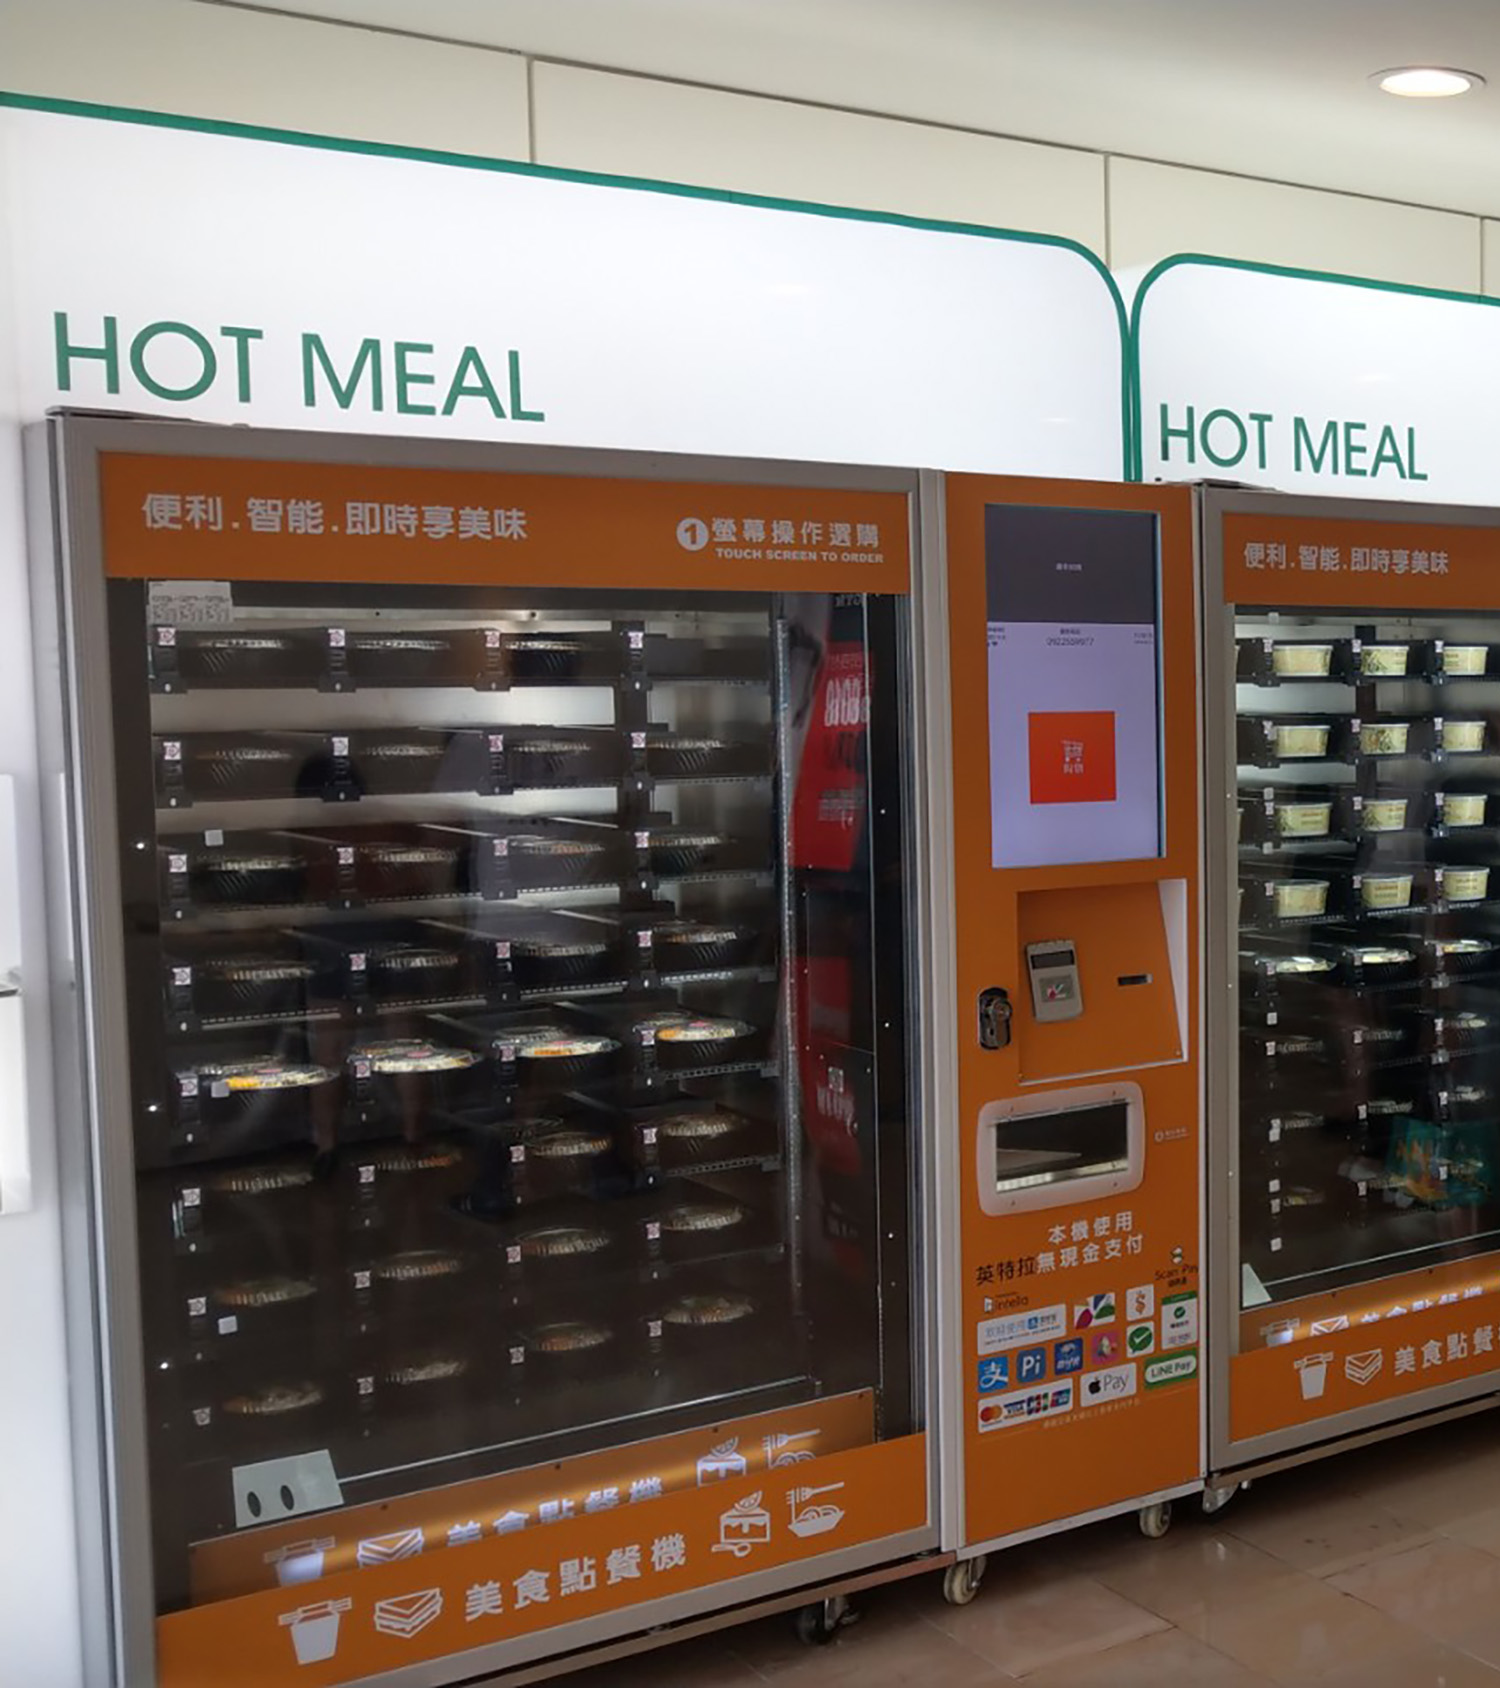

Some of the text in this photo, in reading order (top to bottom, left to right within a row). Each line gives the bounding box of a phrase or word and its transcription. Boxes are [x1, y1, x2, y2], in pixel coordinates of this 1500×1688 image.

[53, 312, 545, 422] HOT MEAL
[1159, 402, 1428, 481] HOT MEAL
[711, 517, 879, 549] 螢幕操作選購
[715, 548, 884, 563] TOUCH SCREEN TO ORDER
[1047, 1210, 1134, 1245] 本機使用
[1036, 1234, 1144, 1274] 無現金支付
[1022, 1355, 1041, 1379] Pi
[1151, 1360, 1192, 1378] LINE Pay
[1103, 1373, 1129, 1396] Pay
[464, 1533, 687, 1622] 美食點餐機
